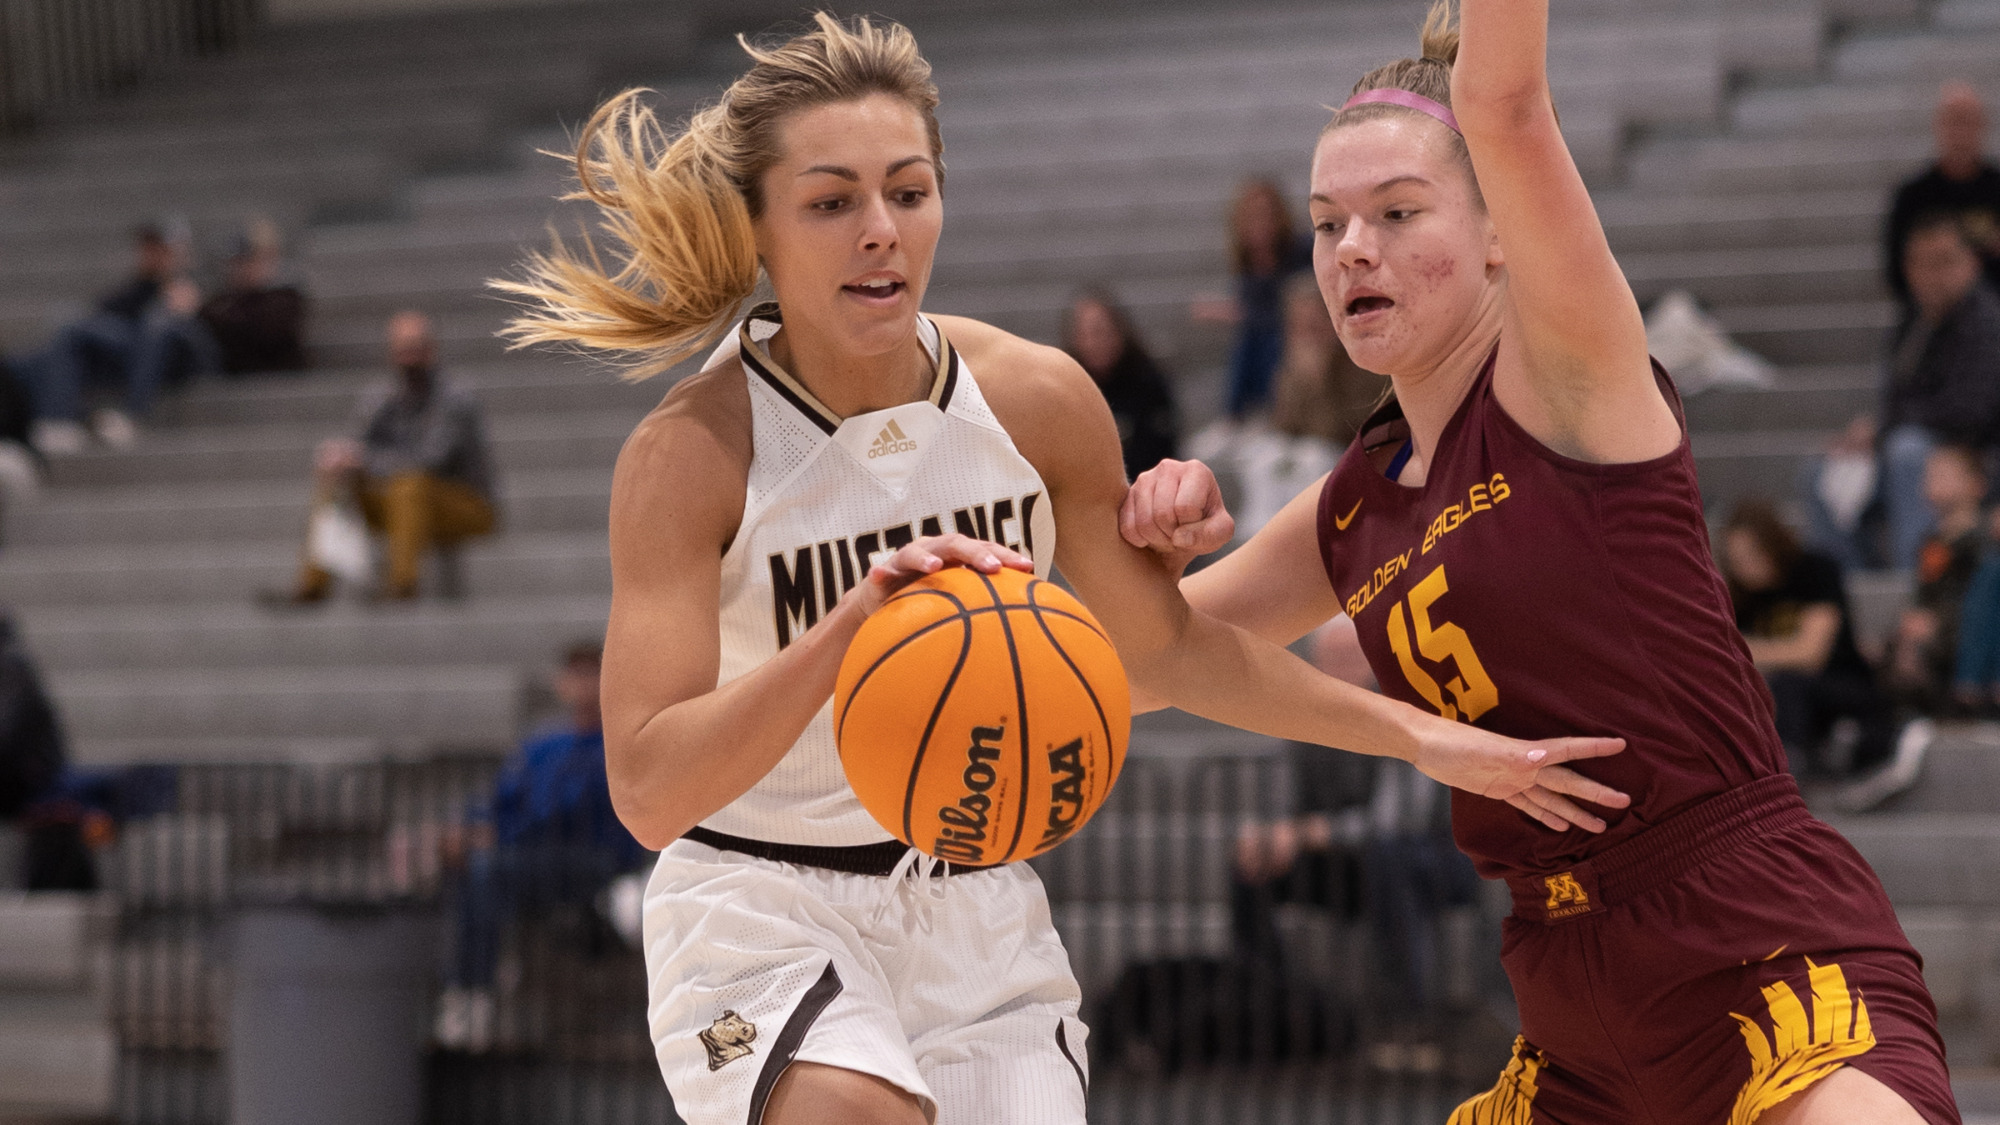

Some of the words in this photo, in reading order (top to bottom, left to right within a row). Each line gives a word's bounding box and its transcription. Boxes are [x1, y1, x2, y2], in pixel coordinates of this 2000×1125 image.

[868, 440, 917, 459] adidas
[1346, 547, 1413, 620] GOLDEN
[1421, 472, 1511, 556] EAGLES
[1386, 563, 1499, 723] 15
[933, 725, 1005, 862] Wilson
